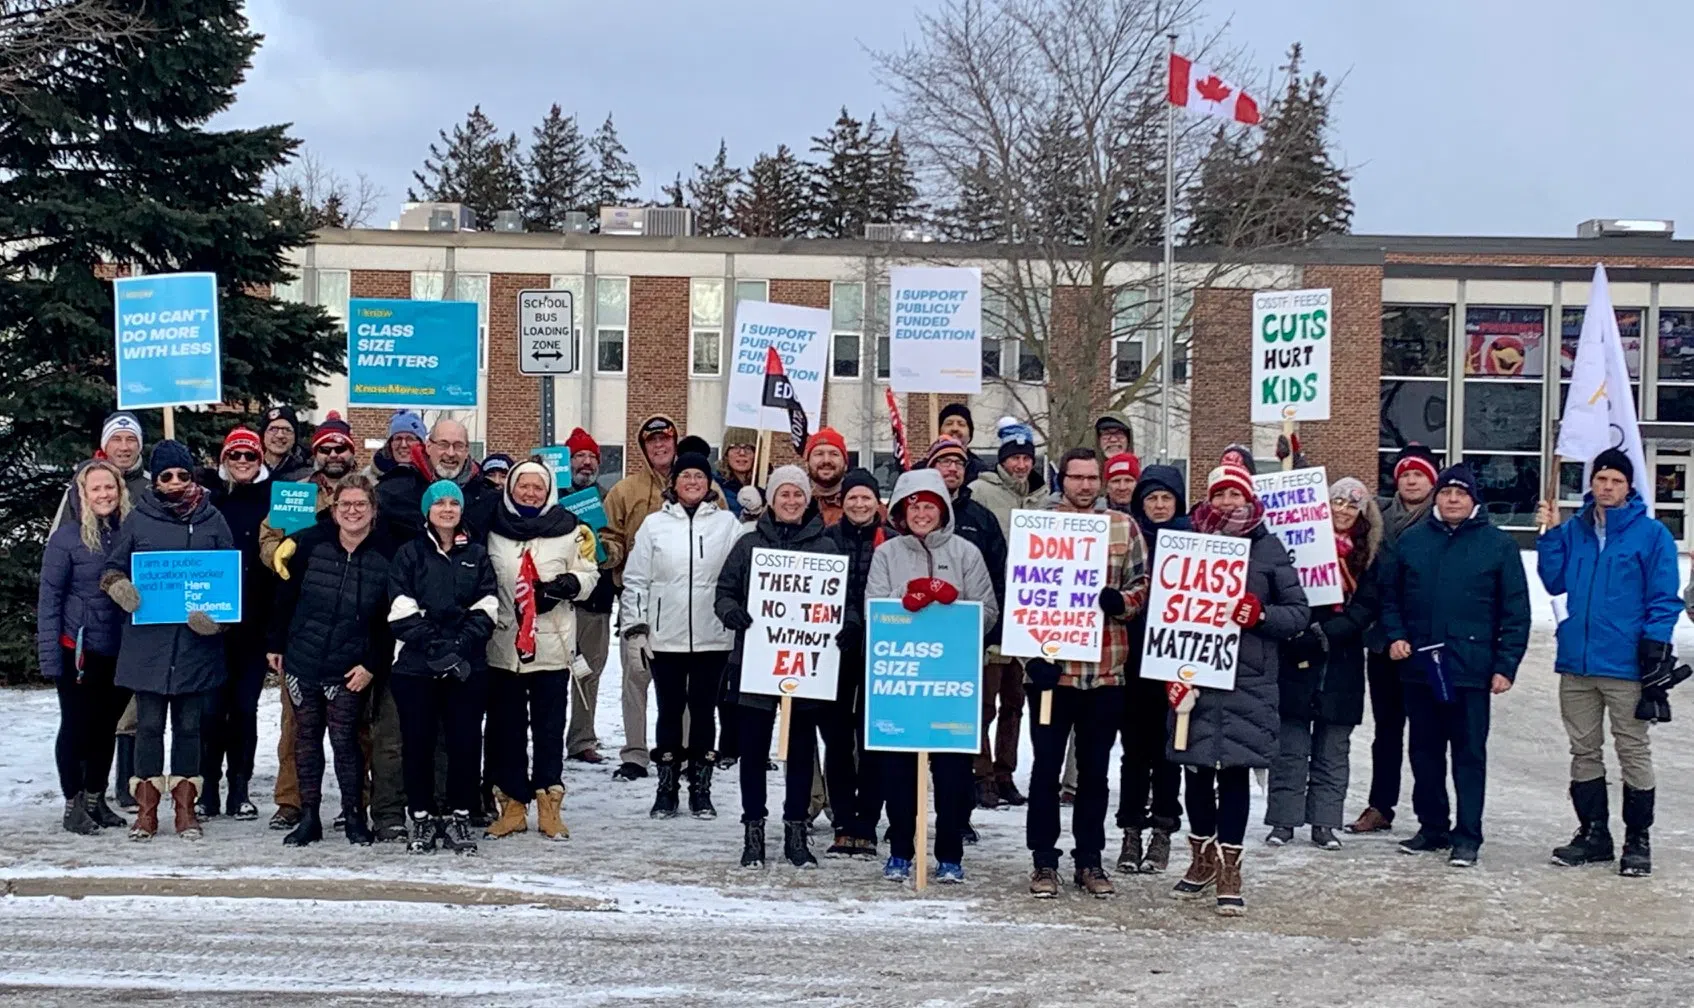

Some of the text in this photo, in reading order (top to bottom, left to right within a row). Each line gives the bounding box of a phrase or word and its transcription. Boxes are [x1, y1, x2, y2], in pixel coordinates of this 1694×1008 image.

[523, 299, 569, 309] SCHOOL
[895, 289, 968, 301] I SUPPORT
[122, 309, 210, 326] YOU CAN'T
[535, 313, 558, 322] BUS
[895, 303, 960, 314] PUBLICLY
[357, 323, 415, 338] CLASS
[895, 316, 950, 327] FUNDED
[1262, 309, 1328, 343] CUTS
[122, 326, 201, 343] DO MORE
[523, 326, 569, 336] LOADING
[741, 323, 817, 342] I SUPPORT
[895, 329, 976, 341] EDUCATION
[123, 342, 212, 360] WITH LESS
[357, 339, 396, 352] SIZE
[532, 340, 561, 350] ZONE
[357, 354, 439, 369] MATTERS
[738, 349, 795, 366] FUNED
[1263, 344, 1314, 370] HURT
[737, 362, 819, 381] EDUTION
[1262, 372, 1319, 405] KIDS
[280, 489, 309, 498] CLASS
[285, 497, 305, 505] SIZE
[1261, 487, 1317, 509] RATHER
[273, 504, 315, 513] MATTERS
[1266, 502, 1329, 526] TEACHING
[1028, 533, 1096, 562] DON'T
[139, 569, 225, 581] education worker
[758, 572, 840, 596] THERE IS
[1012, 565, 1099, 587] MAKE ME
[1160, 554, 1245, 598] CLASS
[1300, 562, 1338, 588] TANT
[184, 580, 210, 590] Here
[184, 590, 203, 600] For
[1018, 588, 1099, 608] USE MY
[761, 600, 842, 625] NO TEAM
[1013, 608, 1097, 628] TEACHER
[1162, 593, 1228, 629] SIZE
[1236, 604, 1253, 624] CAN
[766, 626, 831, 648] WITHOUT
[873, 640, 944, 659] CLASS
[1146, 626, 1238, 672] MATTERS
[772, 650, 820, 677] EA!
[873, 660, 921, 677] SIZE
[873, 679, 975, 698] MATTERS
